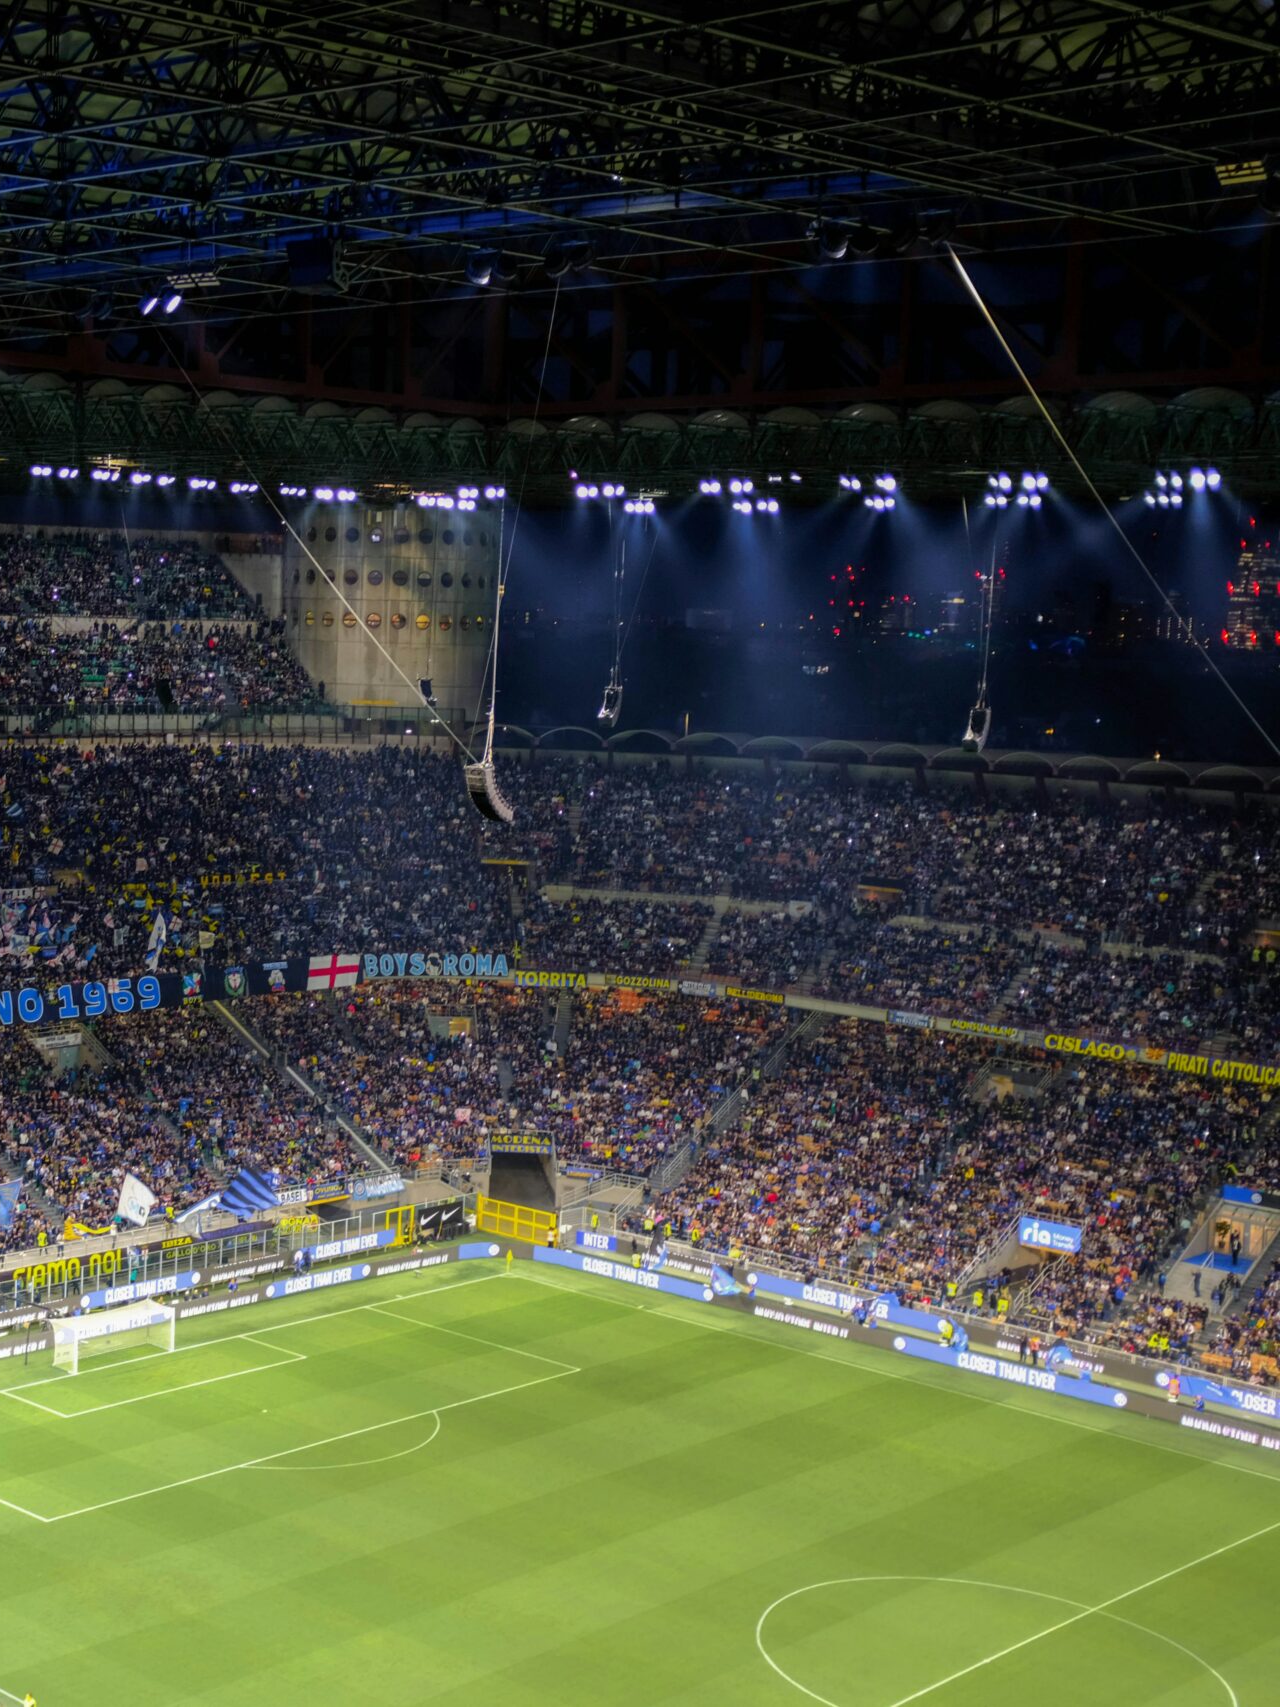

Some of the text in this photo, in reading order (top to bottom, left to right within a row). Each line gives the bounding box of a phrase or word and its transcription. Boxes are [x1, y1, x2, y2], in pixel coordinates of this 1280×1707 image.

[364, 953, 509, 977] BOYS ROMA
[515, 970, 587, 987] TORRITA
[616, 975, 671, 989] GOZZOLINA
[57, 975, 161, 1019] 1969
[1044, 1034, 1126, 1061] CISLAGO
[1167, 1052, 1208, 1076] PIRATI
[491, 1134, 551, 1146] MODENA
[161, 1236, 193, 1249] IBIZA
[583, 1232, 609, 1250] INTER
[1023, 1222, 1051, 1245] ria
[316, 1242, 341, 1258] CLOSER
[361, 1234, 378, 1249] EVER
[89, 1248, 122, 1276] NOI
[583, 1256, 613, 1278] CLOSER
[615, 1264, 637, 1283] THAN
[638, 1270, 660, 1289] EVER
[105, 1283, 134, 1304] CLOSER
[157, 1275, 177, 1293] EVER
[285, 1267, 352, 1294] CLOSER THAN EVER
[802, 1285, 836, 1306] CLOSER
[957, 1352, 1056, 1391] CLOSER THAN EVER
